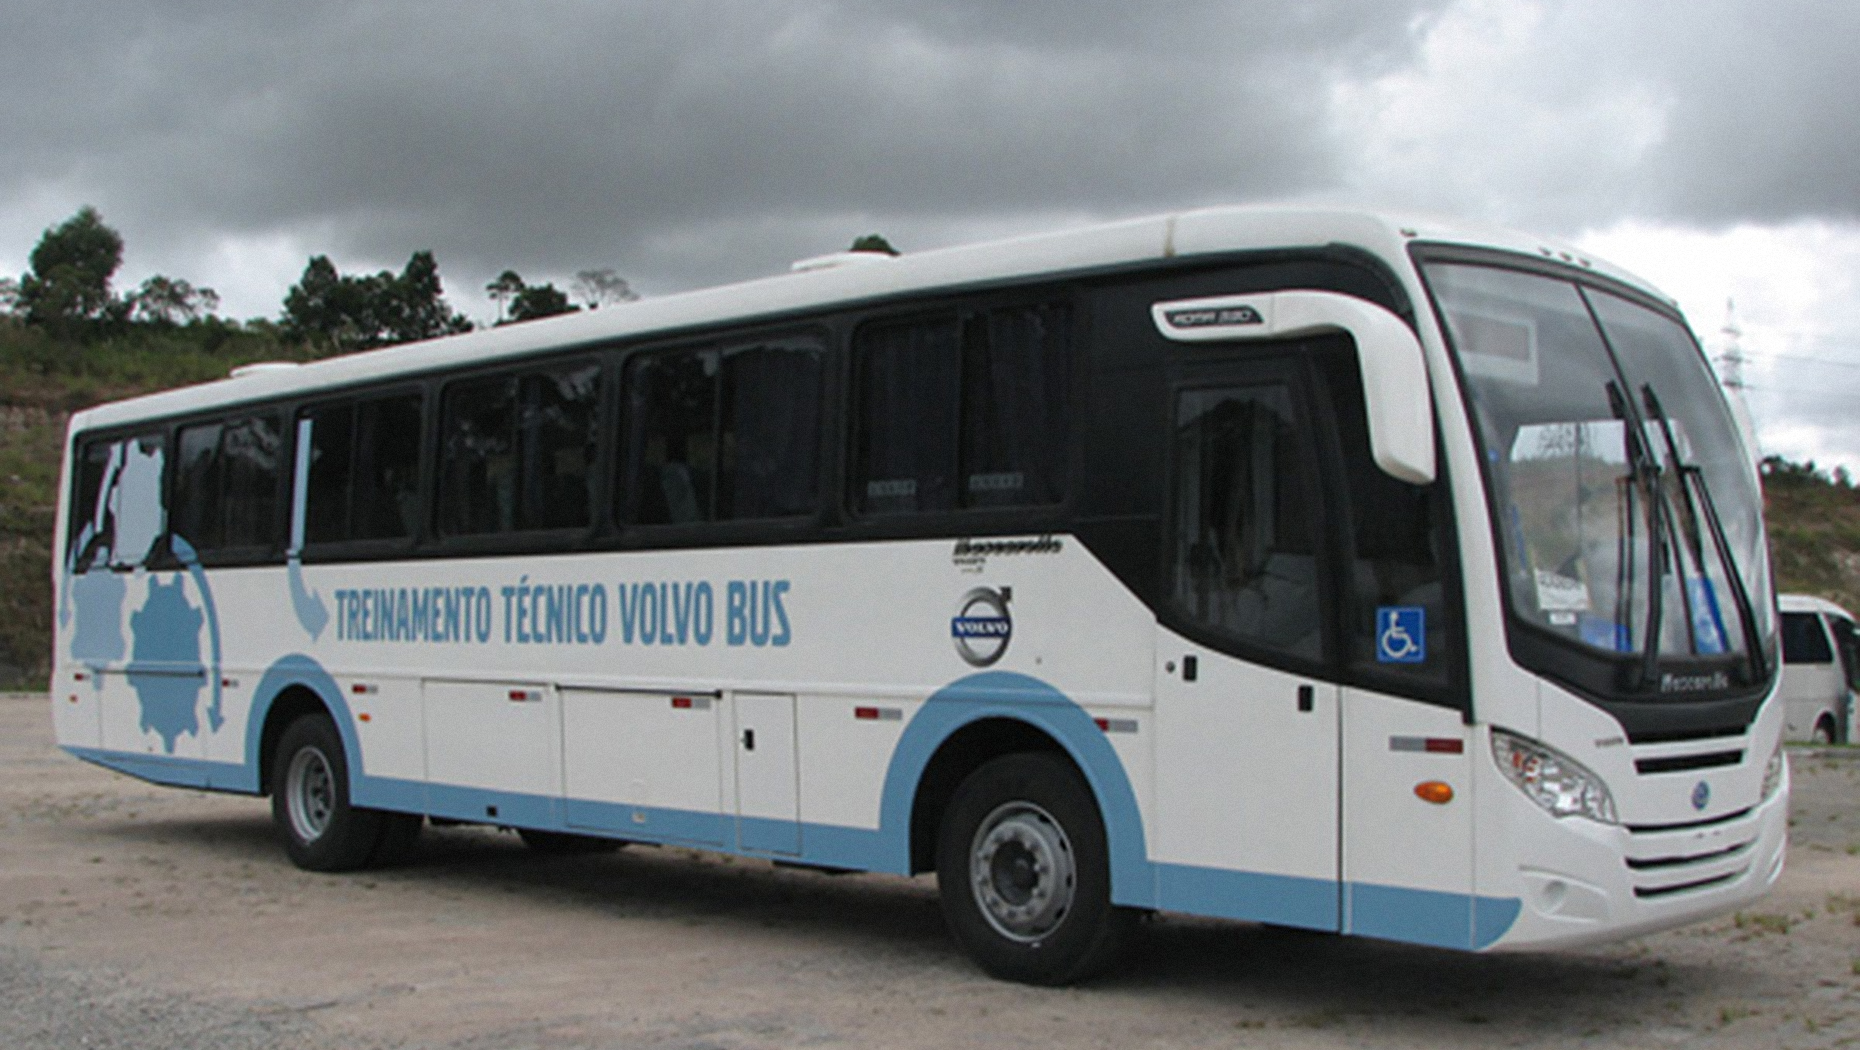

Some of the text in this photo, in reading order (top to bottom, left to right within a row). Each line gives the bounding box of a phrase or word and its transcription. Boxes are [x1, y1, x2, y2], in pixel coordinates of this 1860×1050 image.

[334, 576, 792, 647] TREINAMENTO TÉCNICO VOLVO BUS
[956, 621, 1009, 635] VOLVO
